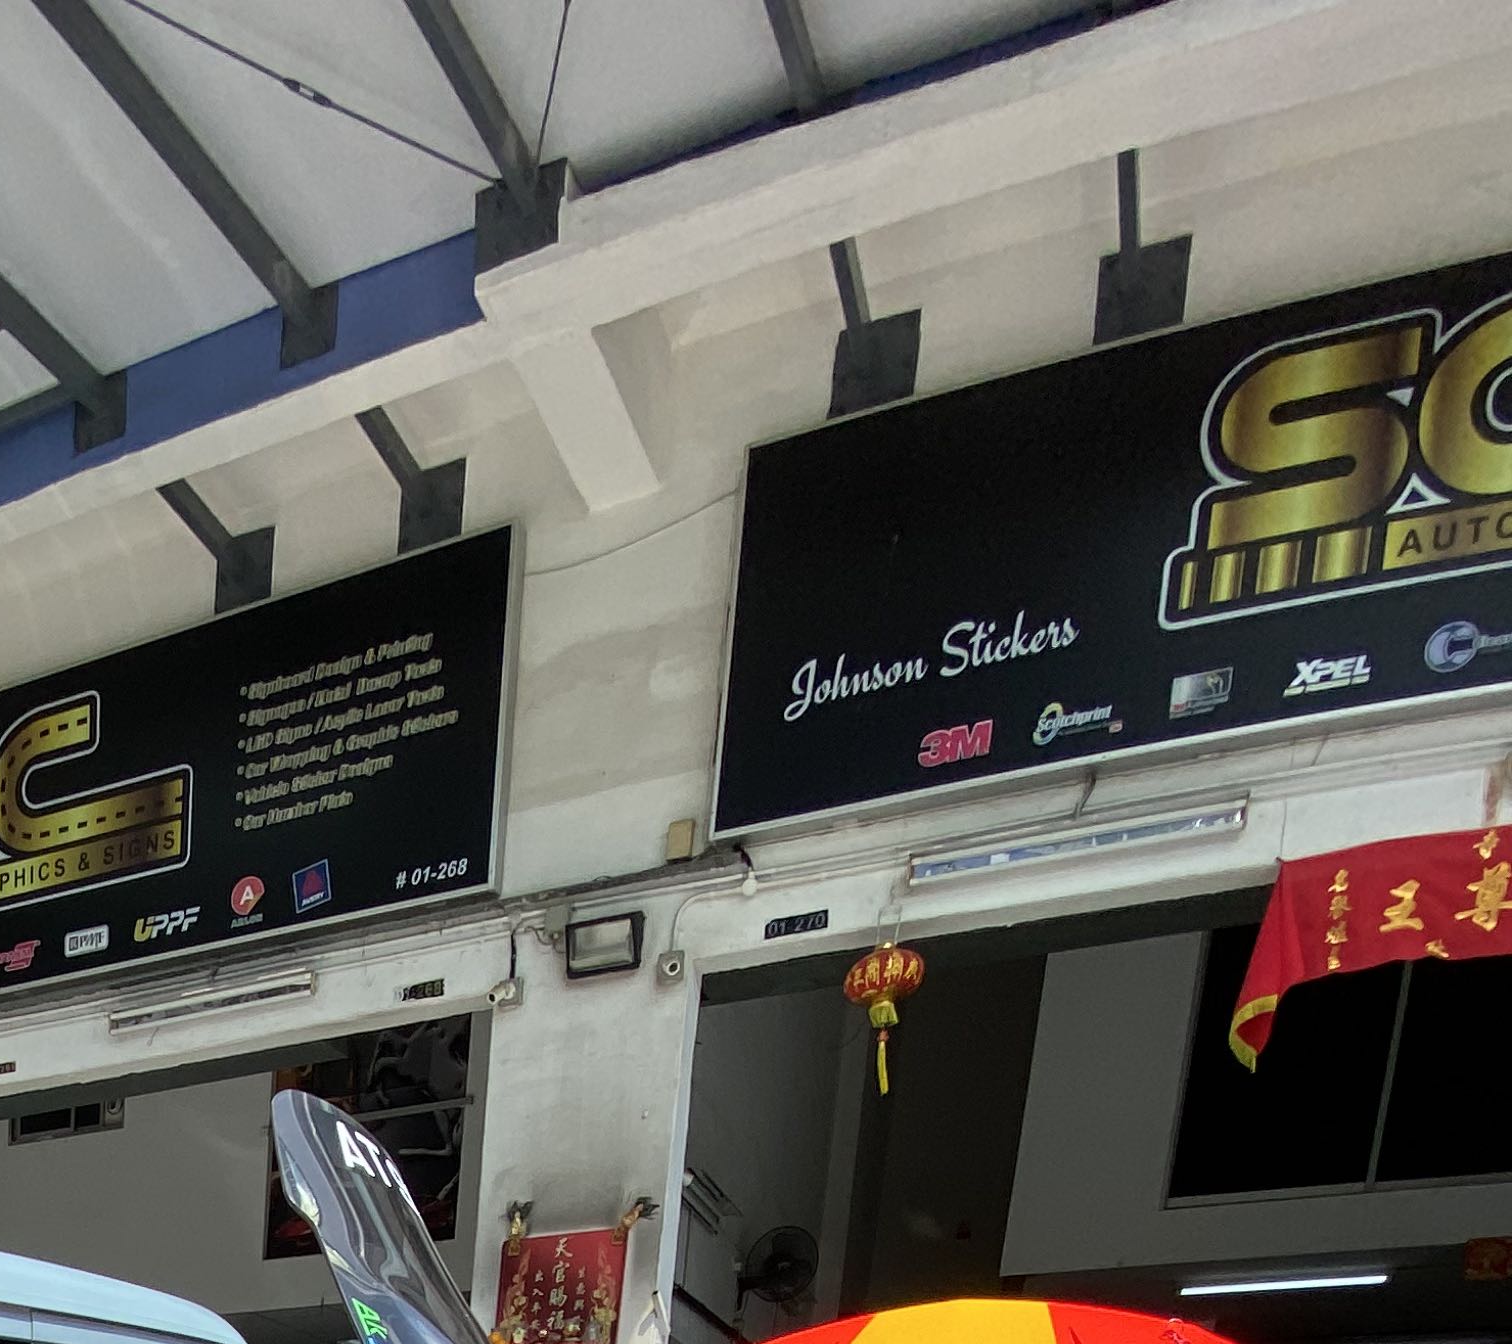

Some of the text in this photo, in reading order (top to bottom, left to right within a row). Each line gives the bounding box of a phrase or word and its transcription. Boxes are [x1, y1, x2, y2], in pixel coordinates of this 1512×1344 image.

[784, 610, 1080, 722] Johnson Stickers
[1288, 654, 1372, 688] XPEL
[918, 720, 993, 768] 3M
[78, 854, 90, 872] &
[102, 829, 176, 866] SIGNS
[395, 858, 468, 890] # 01-268
[133, 906, 201, 942] UPPF
